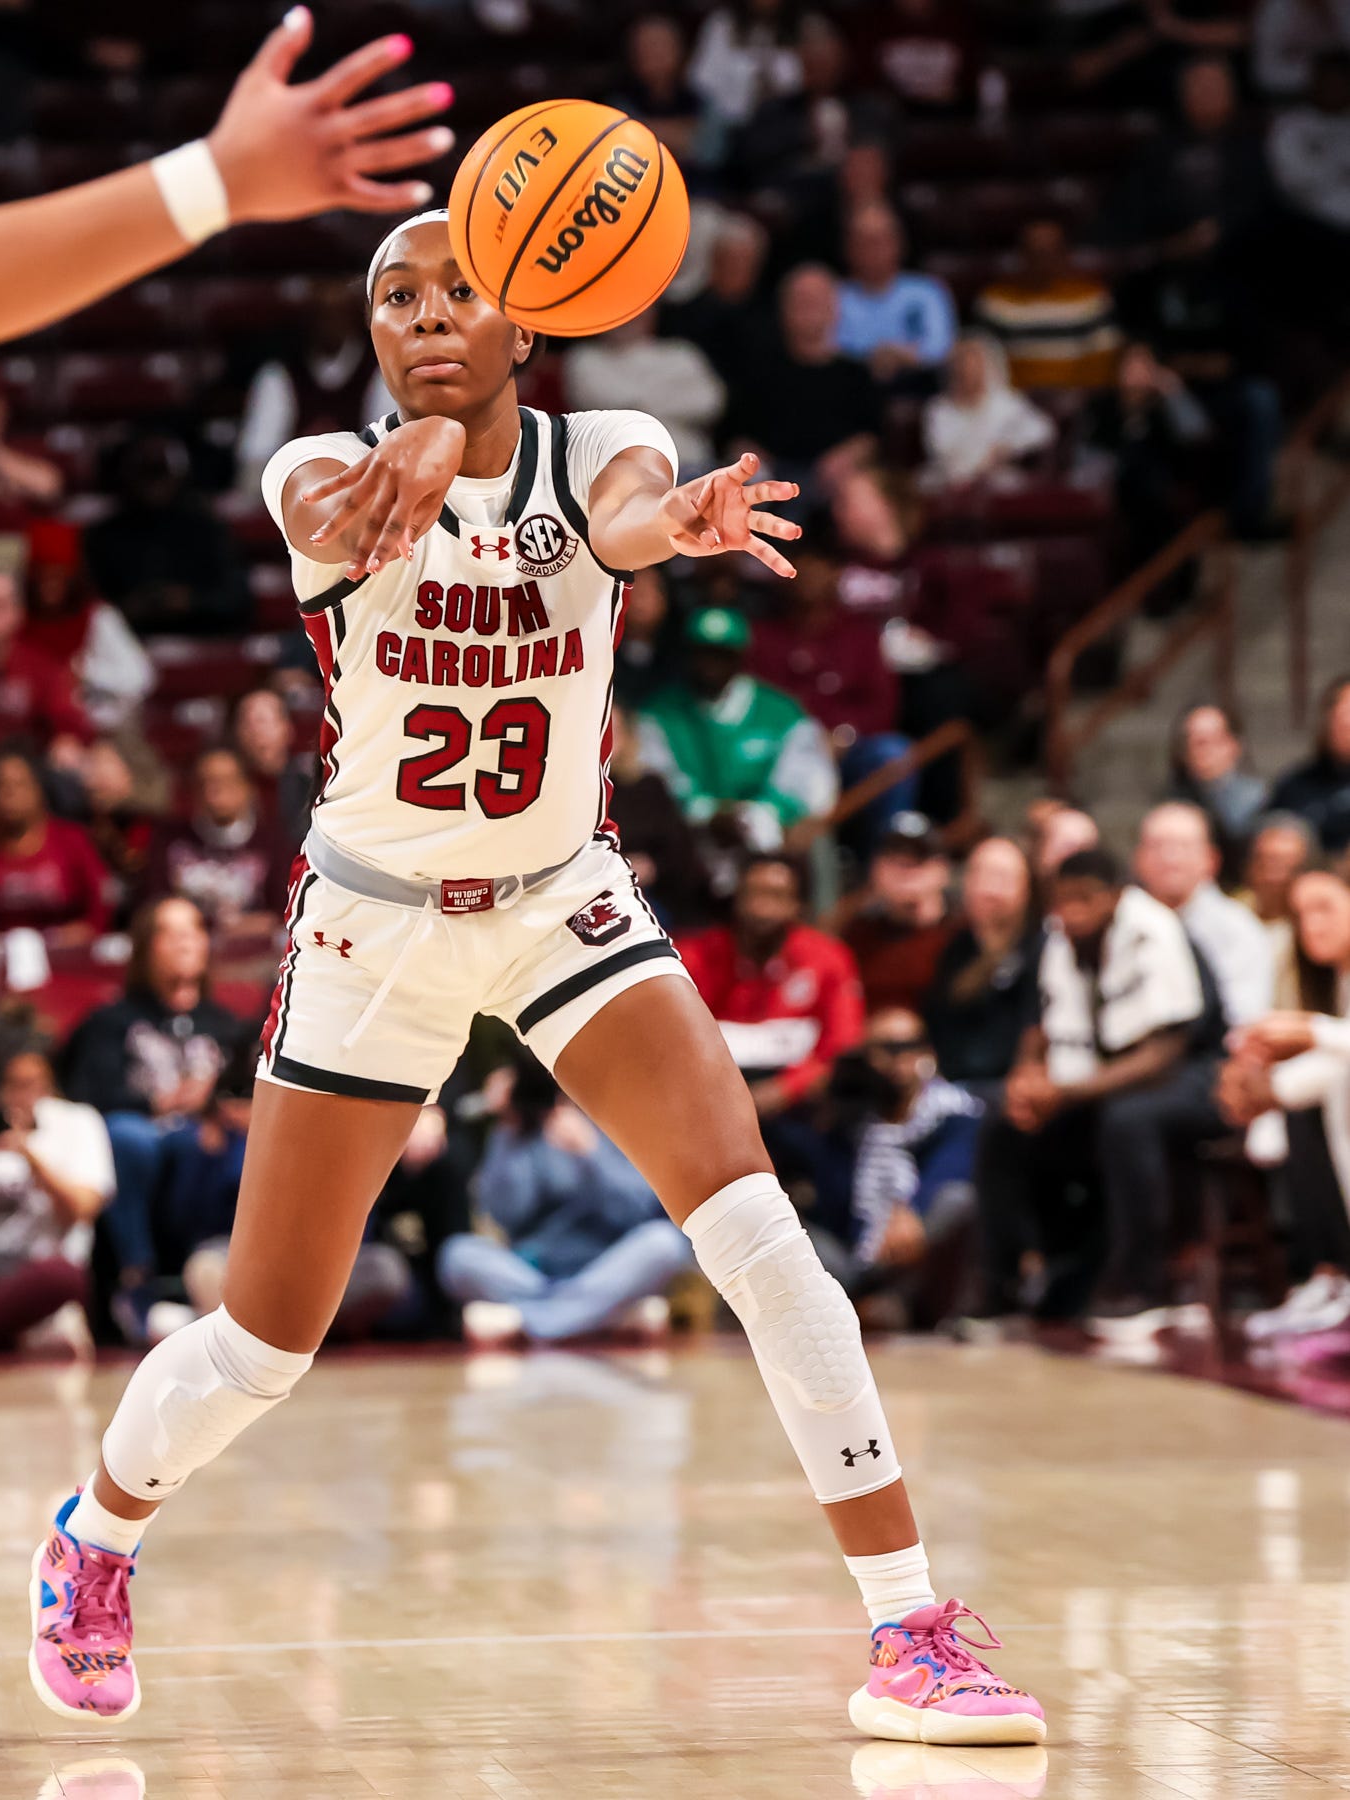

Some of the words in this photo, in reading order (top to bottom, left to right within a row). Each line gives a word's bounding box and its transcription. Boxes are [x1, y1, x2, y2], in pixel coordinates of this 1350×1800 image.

[494, 126, 558, 212] EVO
[535, 146, 650, 274] Wilson
[519, 517, 562, 561] SEC
[521, 550, 573, 576] GRADUATE
[414, 580, 551, 637] SOUTH
[375, 627, 584, 689] CAROLINA
[395, 696, 552, 819] 23
[447, 887, 489, 899] CAROLINA
[454, 896, 482, 906] SOUTH
